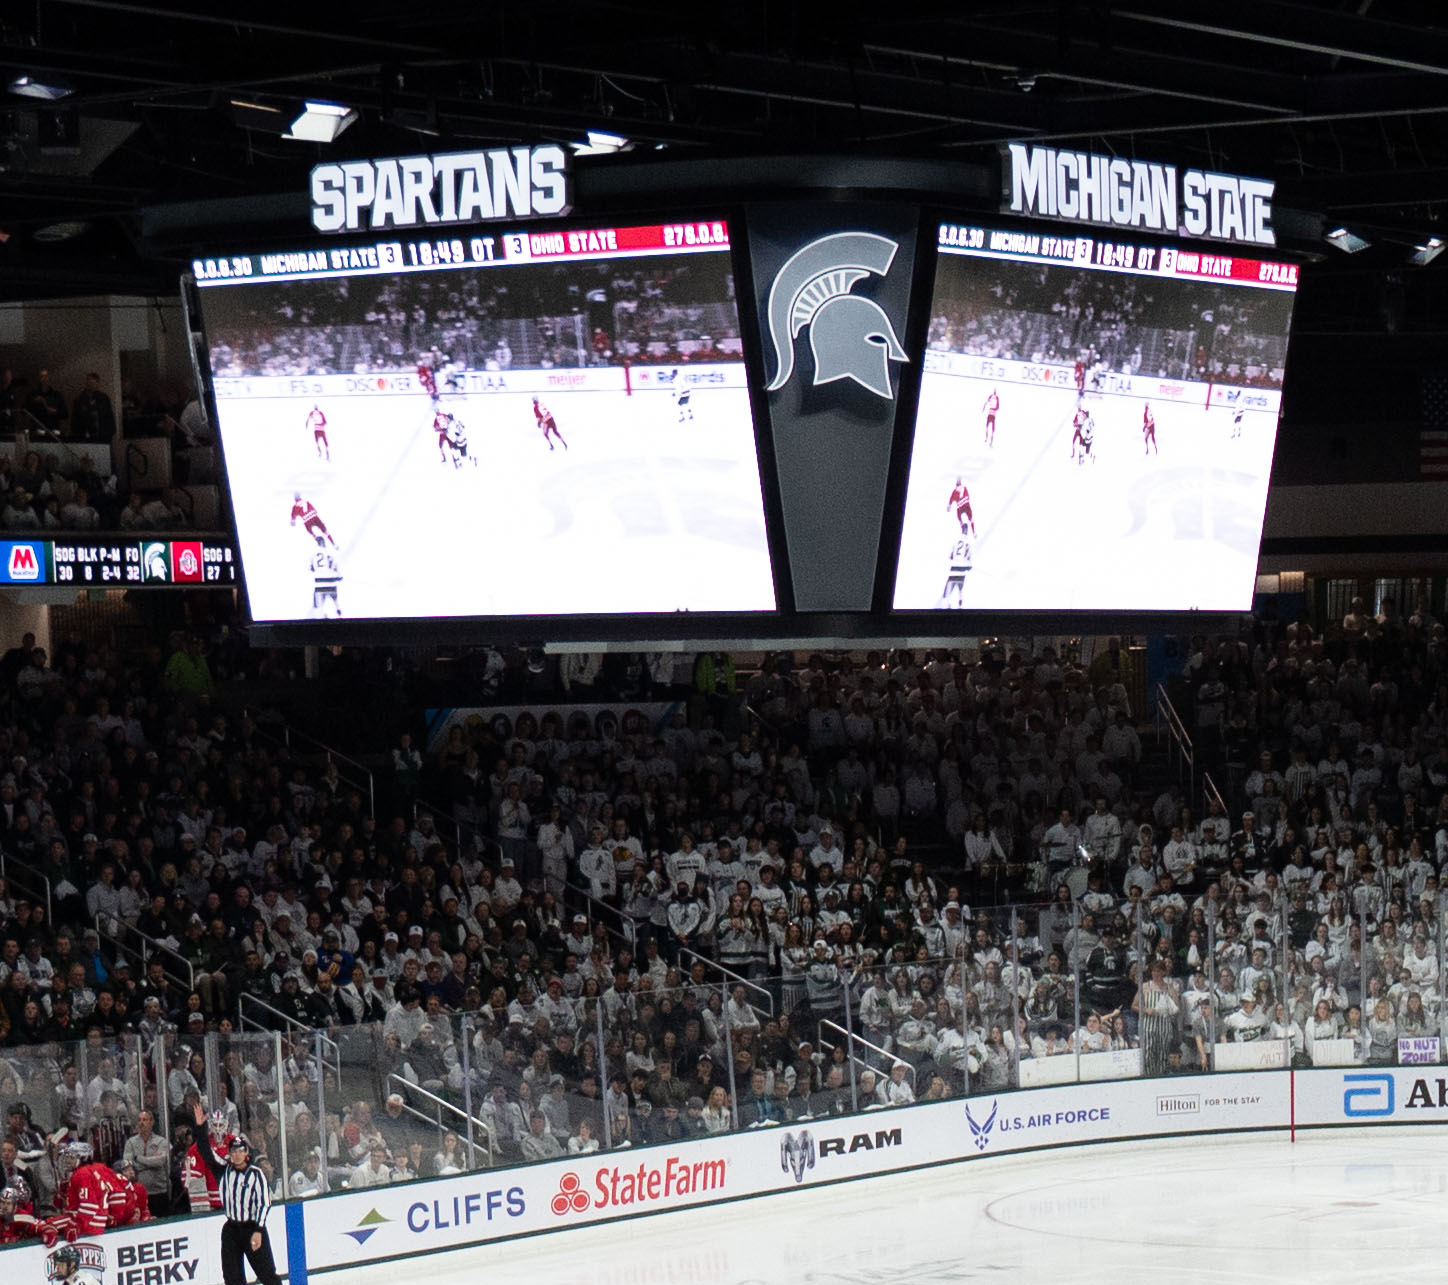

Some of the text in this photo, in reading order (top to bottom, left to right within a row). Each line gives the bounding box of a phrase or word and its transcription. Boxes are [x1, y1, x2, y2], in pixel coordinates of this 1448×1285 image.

[311, 144, 569, 231] SPARTANS
[1009, 143, 1276, 246] MICHIGAN STATE
[260, 250, 328, 276] MICHIGAN
[331, 247, 378, 270] STATE
[386, 246, 396, 264] 3
[409, 238, 464, 266] 18:49
[471, 239, 496, 262] OT
[512, 237, 524, 257] 3
[531, 232, 565, 256] OHIO
[568, 229, 619, 254] STATE
[990, 230, 1040, 256] MICHIGAN
[1041, 235, 1076, 261] STATE
[1096, 239, 1135, 267] 18:49
[1137, 247, 1155, 270] OT
[1176, 250, 1200, 275] OHIO
[1200, 254, 1233, 278] STATE
[13, 549, 35, 569] M
[55, 547, 76, 562] SOG
[203, 547, 224, 562] SOG
[58, 565, 73, 581] 30
[102, 565, 122, 581] 2-4
[126, 565, 140, 581] 32
[207, 565, 220, 581] 27
[1399, 1037, 1438, 1050] NO NUT
[1401, 1051, 1437, 1063] ZONE
[1159, 1099, 1197, 1114] Hilton
[1204, 1095, 1261, 1107] FOR THE STAY
[999, 1107, 1110, 1132] U.S. AIR FORCE
[819, 1128, 902, 1158] RAM
[594, 1156, 727, 1209] StateFarm
[407, 1186, 526, 1234] CLIFFS
[117, 1237, 189, 1268] BEEF
